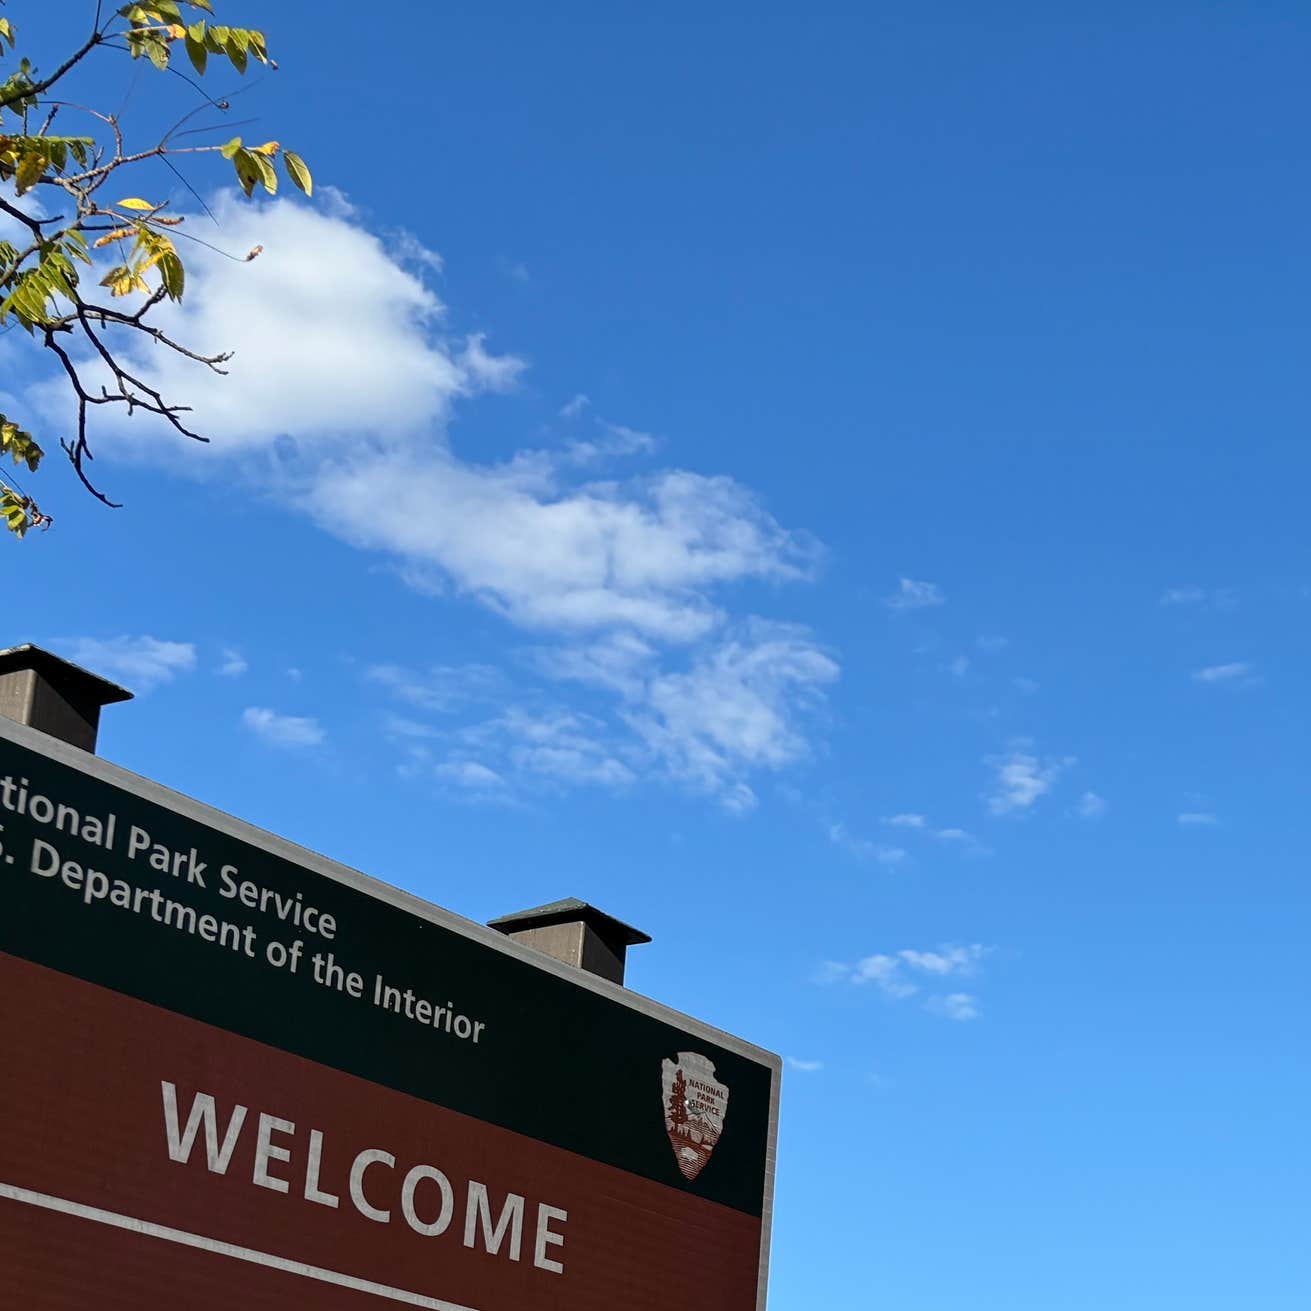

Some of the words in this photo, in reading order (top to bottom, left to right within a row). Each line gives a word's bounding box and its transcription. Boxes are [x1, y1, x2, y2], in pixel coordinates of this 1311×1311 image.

[0, 775, 116, 850] tional
[129, 826, 207, 888] Park
[220, 864, 337, 939] Service
[31, 838, 257, 958] Department
[266, 940, 304, 974] of
[312, 953, 364, 998] the
[373, 974, 485, 1044] Interior
[688, 1079, 724, 1099] NATIONAL
[690, 1099, 720, 1116] SERVICE
[696, 1092, 715, 1105] PARK
[162, 1080, 569, 1275] WELCOME
